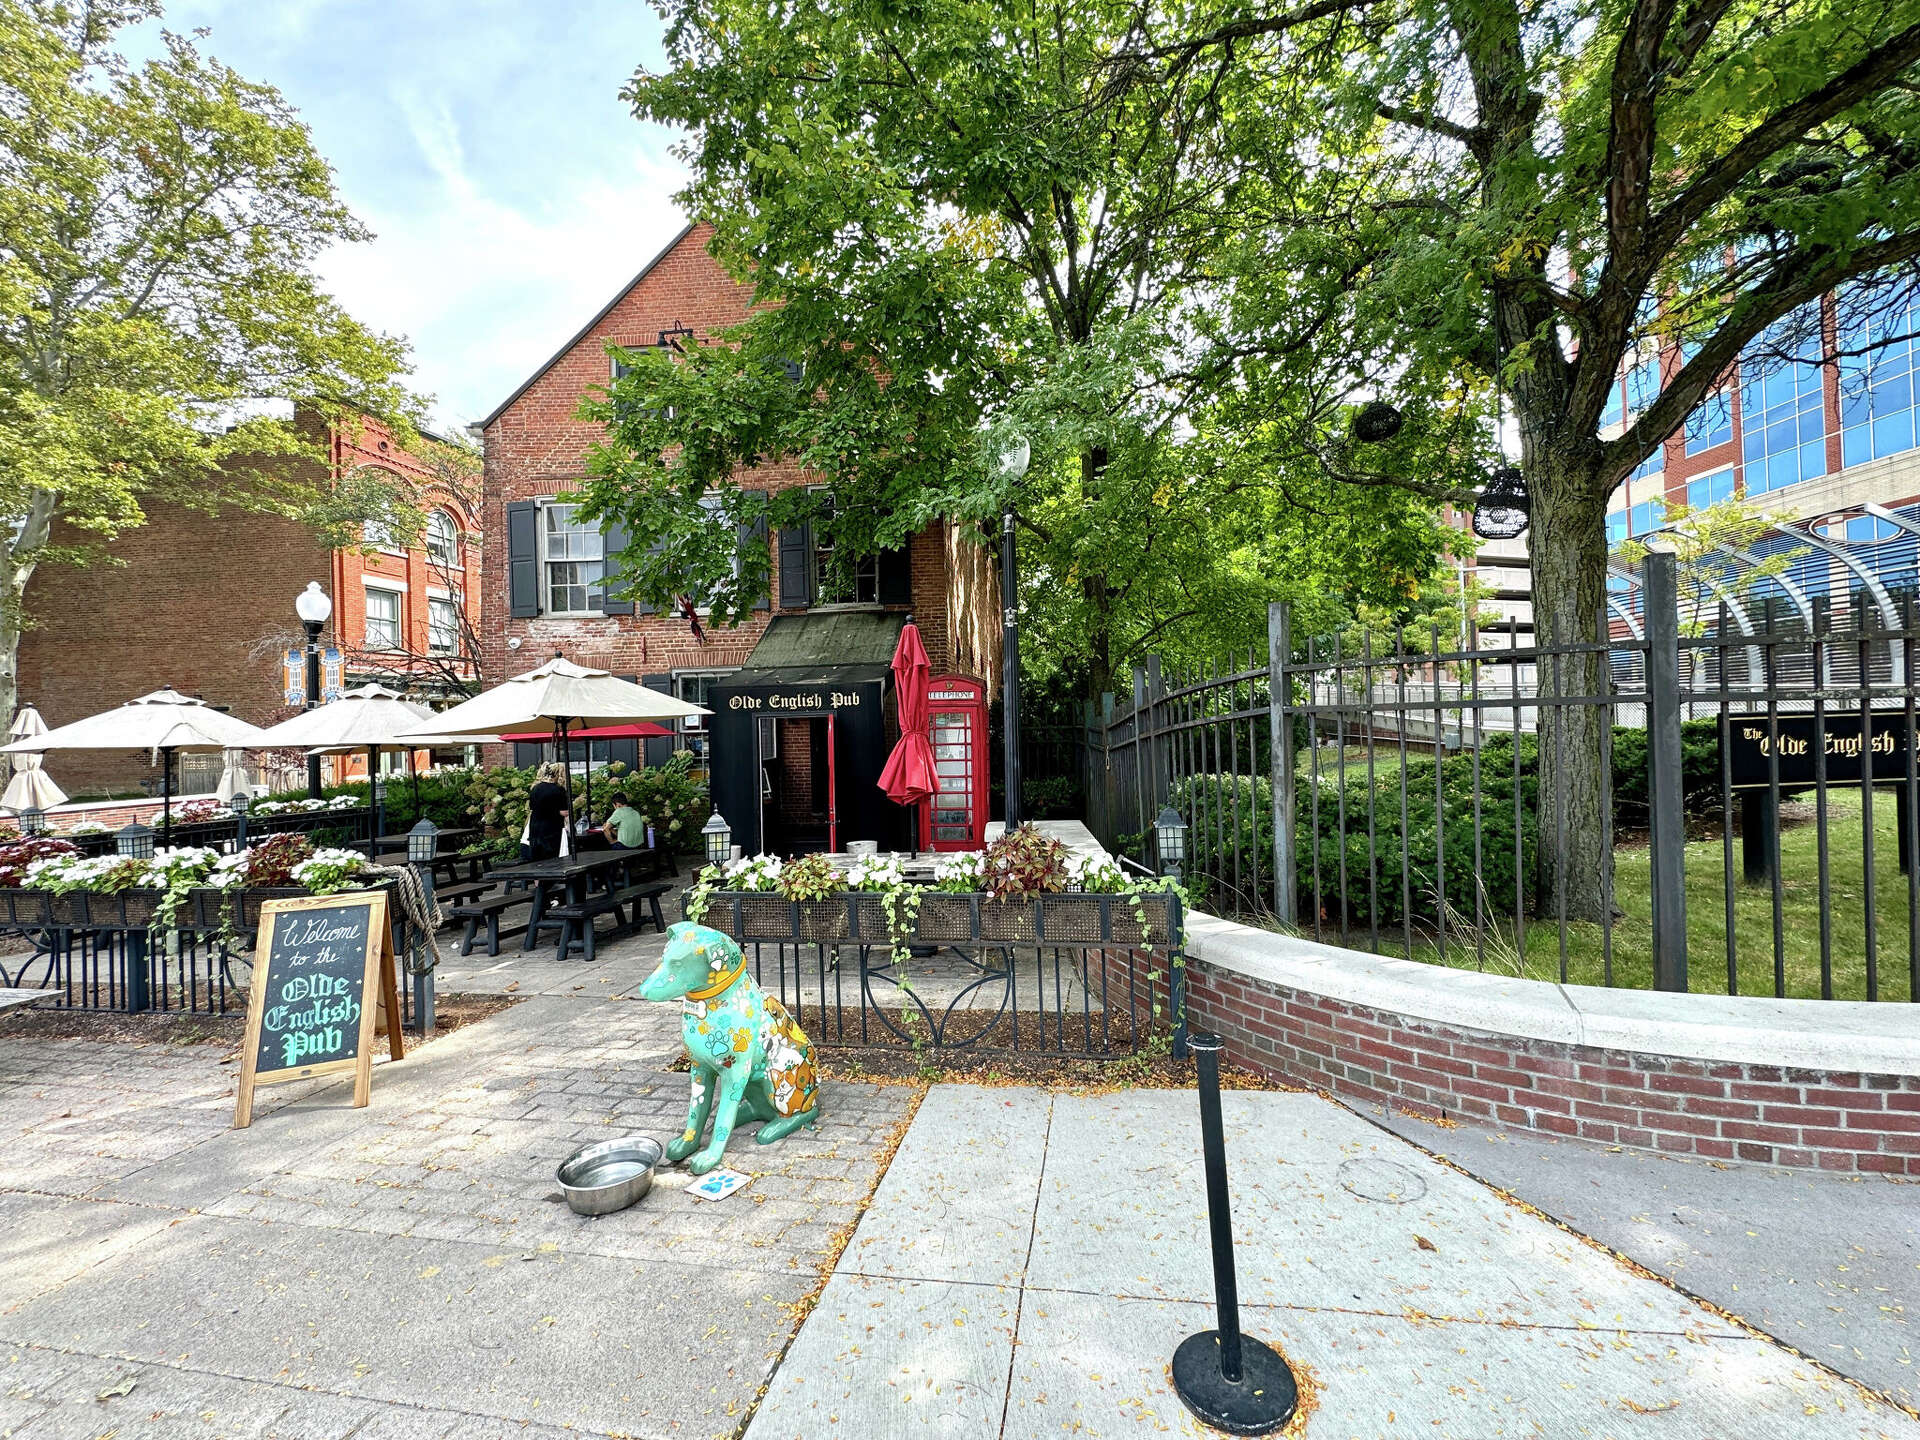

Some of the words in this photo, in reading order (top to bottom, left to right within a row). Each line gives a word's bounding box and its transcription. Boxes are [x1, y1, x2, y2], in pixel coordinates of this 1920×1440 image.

[729, 694, 762, 710] Olde
[769, 693, 822, 710] English
[830, 691, 860, 709] Pub
[928, 691, 972, 699] TELEPHONE
[1743, 727, 1763, 740] The
[1823, 730, 1895, 758] Englsh
[281, 918, 361, 947] Welcome
[289, 954, 310, 968] to
[314, 946, 340, 965] the
[281, 972, 350, 1002] Olde
[264, 995, 361, 1032] English
[280, 1026, 343, 1067] Pub
